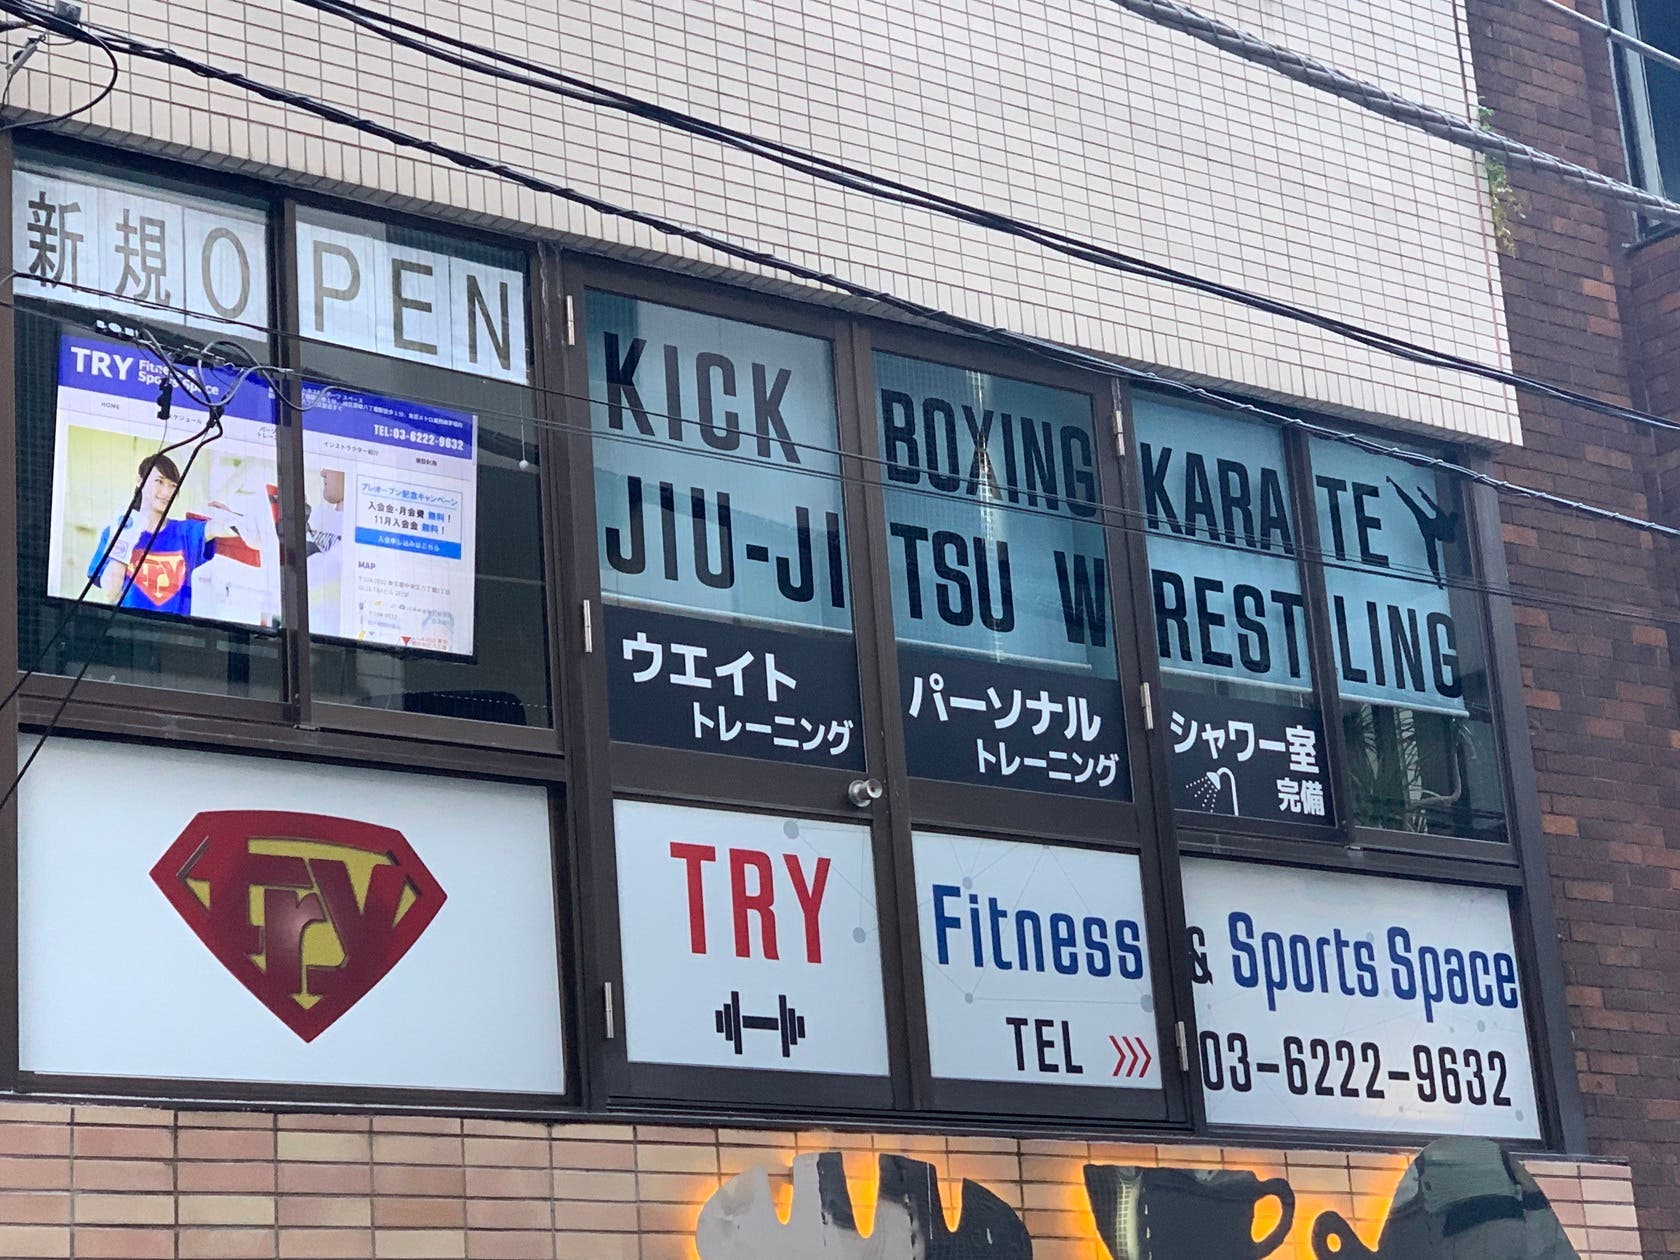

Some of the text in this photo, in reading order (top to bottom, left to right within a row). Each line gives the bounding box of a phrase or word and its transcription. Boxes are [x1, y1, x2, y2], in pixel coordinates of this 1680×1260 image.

[71, 346, 134, 381] TRY
[101, 402, 120, 410] HOME
[603, 331, 801, 464] KICK
[880, 388, 1097, 517] BOXING
[358, 560, 376, 570] MAP
[623, 631, 798, 703] ウエイト
[692, 702, 853, 756] トレーニング
[909, 672, 1102, 742] パーソナル
[977, 739, 1119, 787] トレーニング
[1170, 710, 1320, 774] シャワー室
[1276, 777, 1326, 817] 完備
[670, 841, 832, 965] TRY
[932, 884, 1144, 980] Fitness
[1228, 911, 1380, 1012] Sports
[1386, 926, 1519, 1023] Space
[1006, 1016, 1512, 1107] TEL 03-6222-9632
